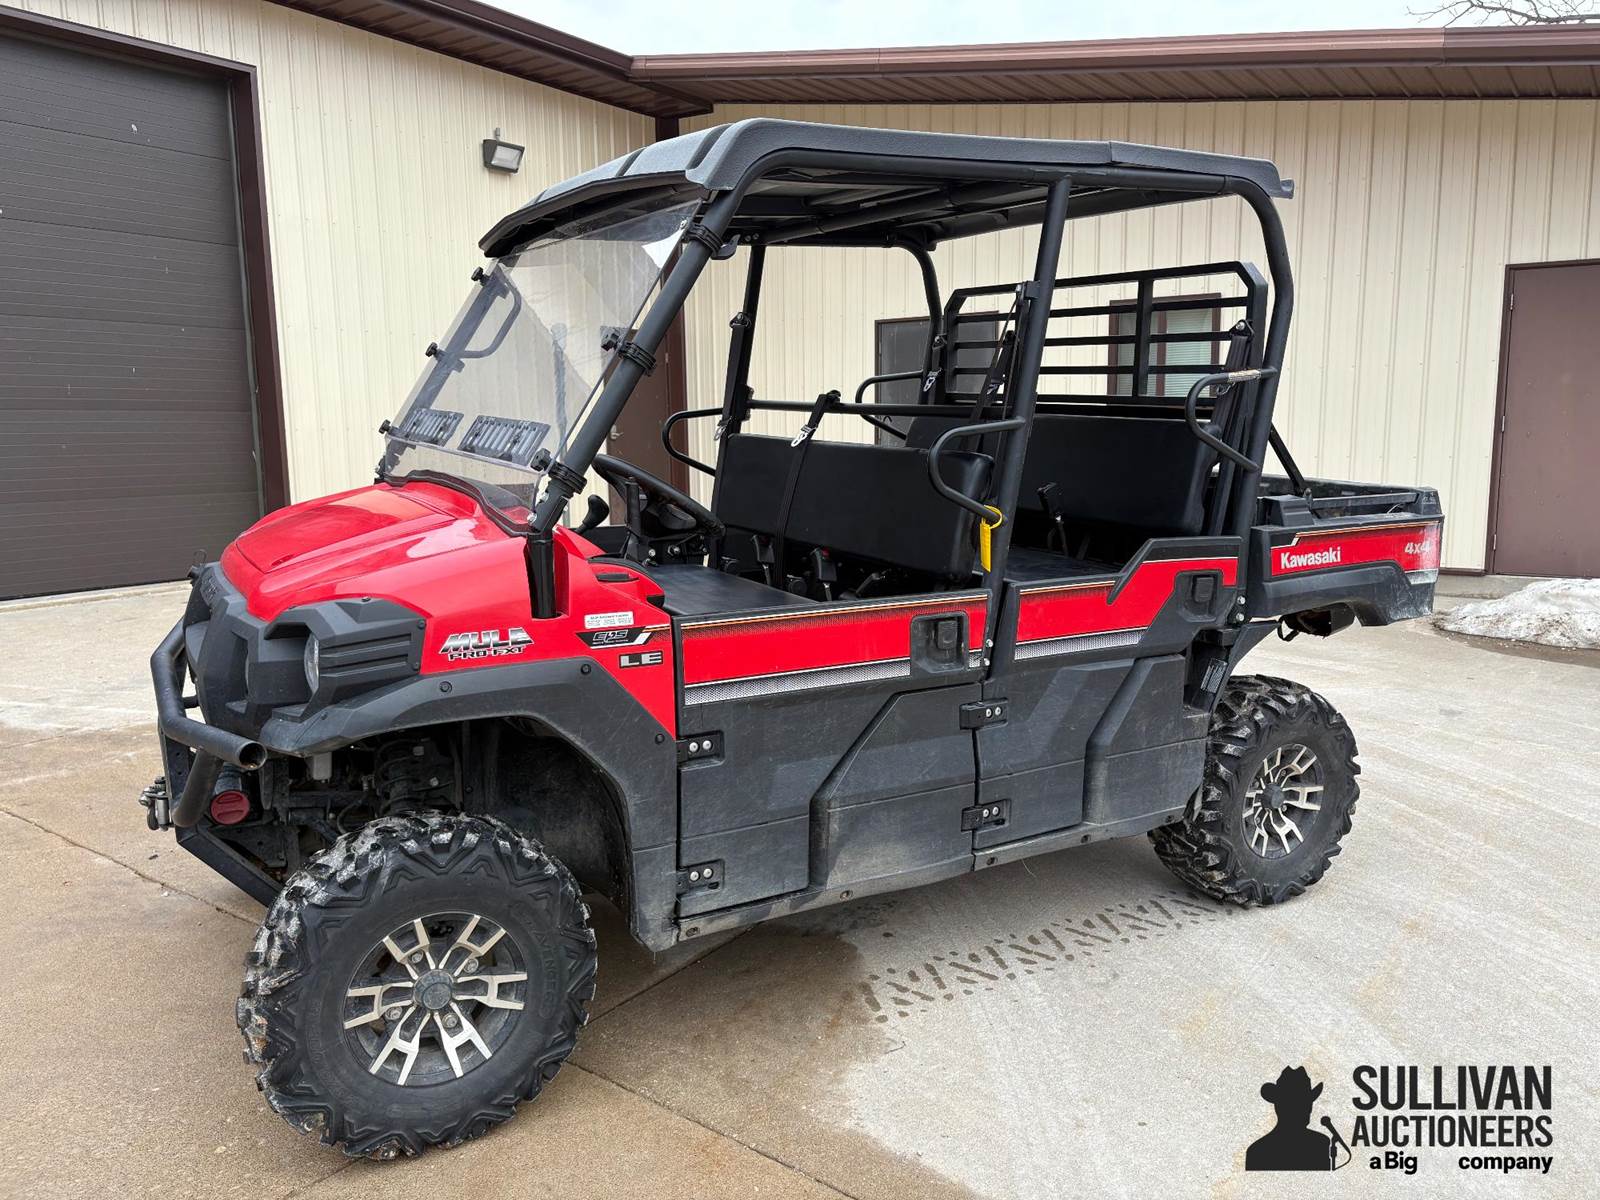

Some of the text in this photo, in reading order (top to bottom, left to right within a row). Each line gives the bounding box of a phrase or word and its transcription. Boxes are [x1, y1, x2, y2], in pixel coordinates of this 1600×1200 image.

[1404, 541, 1432, 555] 4x4
[1280, 546, 1341, 570] Kawasaki
[439, 627, 534, 654] MULE
[448, 645, 526, 661] PRO FXT
[620, 652, 662, 667] LE
